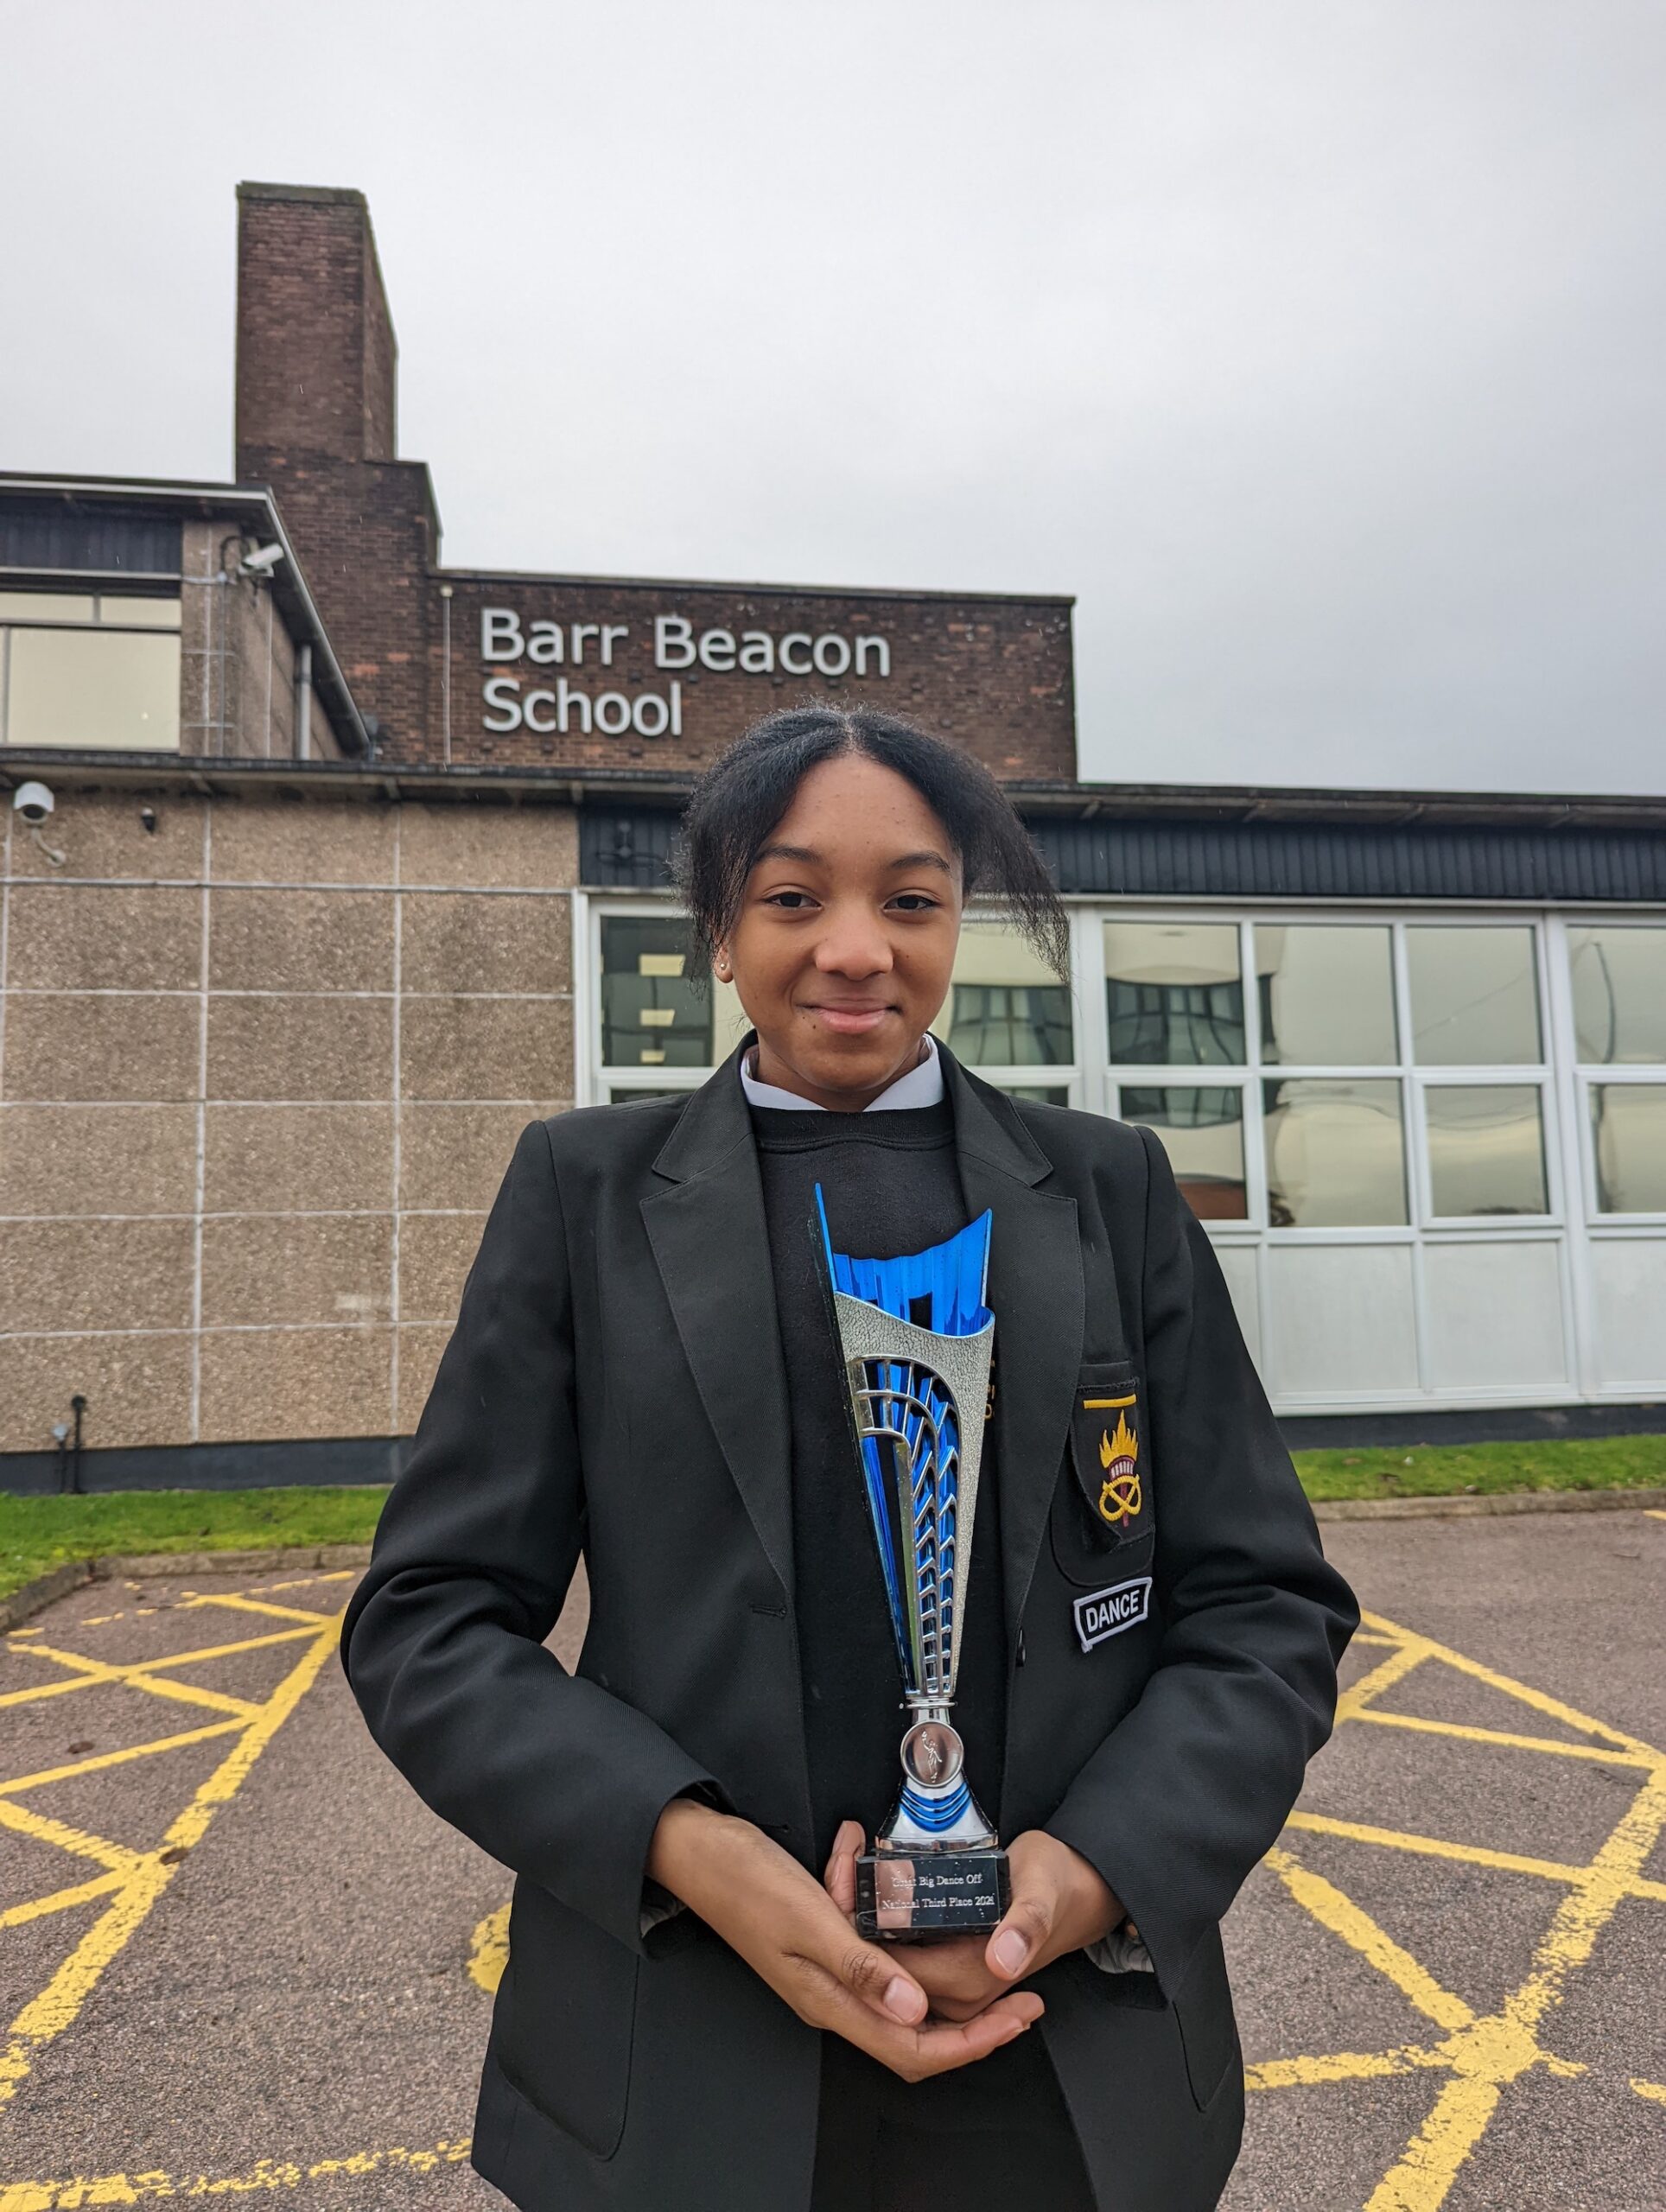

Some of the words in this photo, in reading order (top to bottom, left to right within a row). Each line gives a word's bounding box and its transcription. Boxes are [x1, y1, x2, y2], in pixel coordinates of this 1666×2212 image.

[480, 607, 629, 666] Barr
[654, 614, 891, 677] Beacon
[481, 677, 683, 736] School
[1085, 1589, 1140, 1634] DANCE
[919, 1876, 935, 1888] Big
[936, 1876, 964, 1885] Dance
[966, 1873, 982, 1885] Off
[882, 1899, 920, 1910] National
[922, 1897, 947, 1908] Third
[949, 1897, 973, 1907] Place
